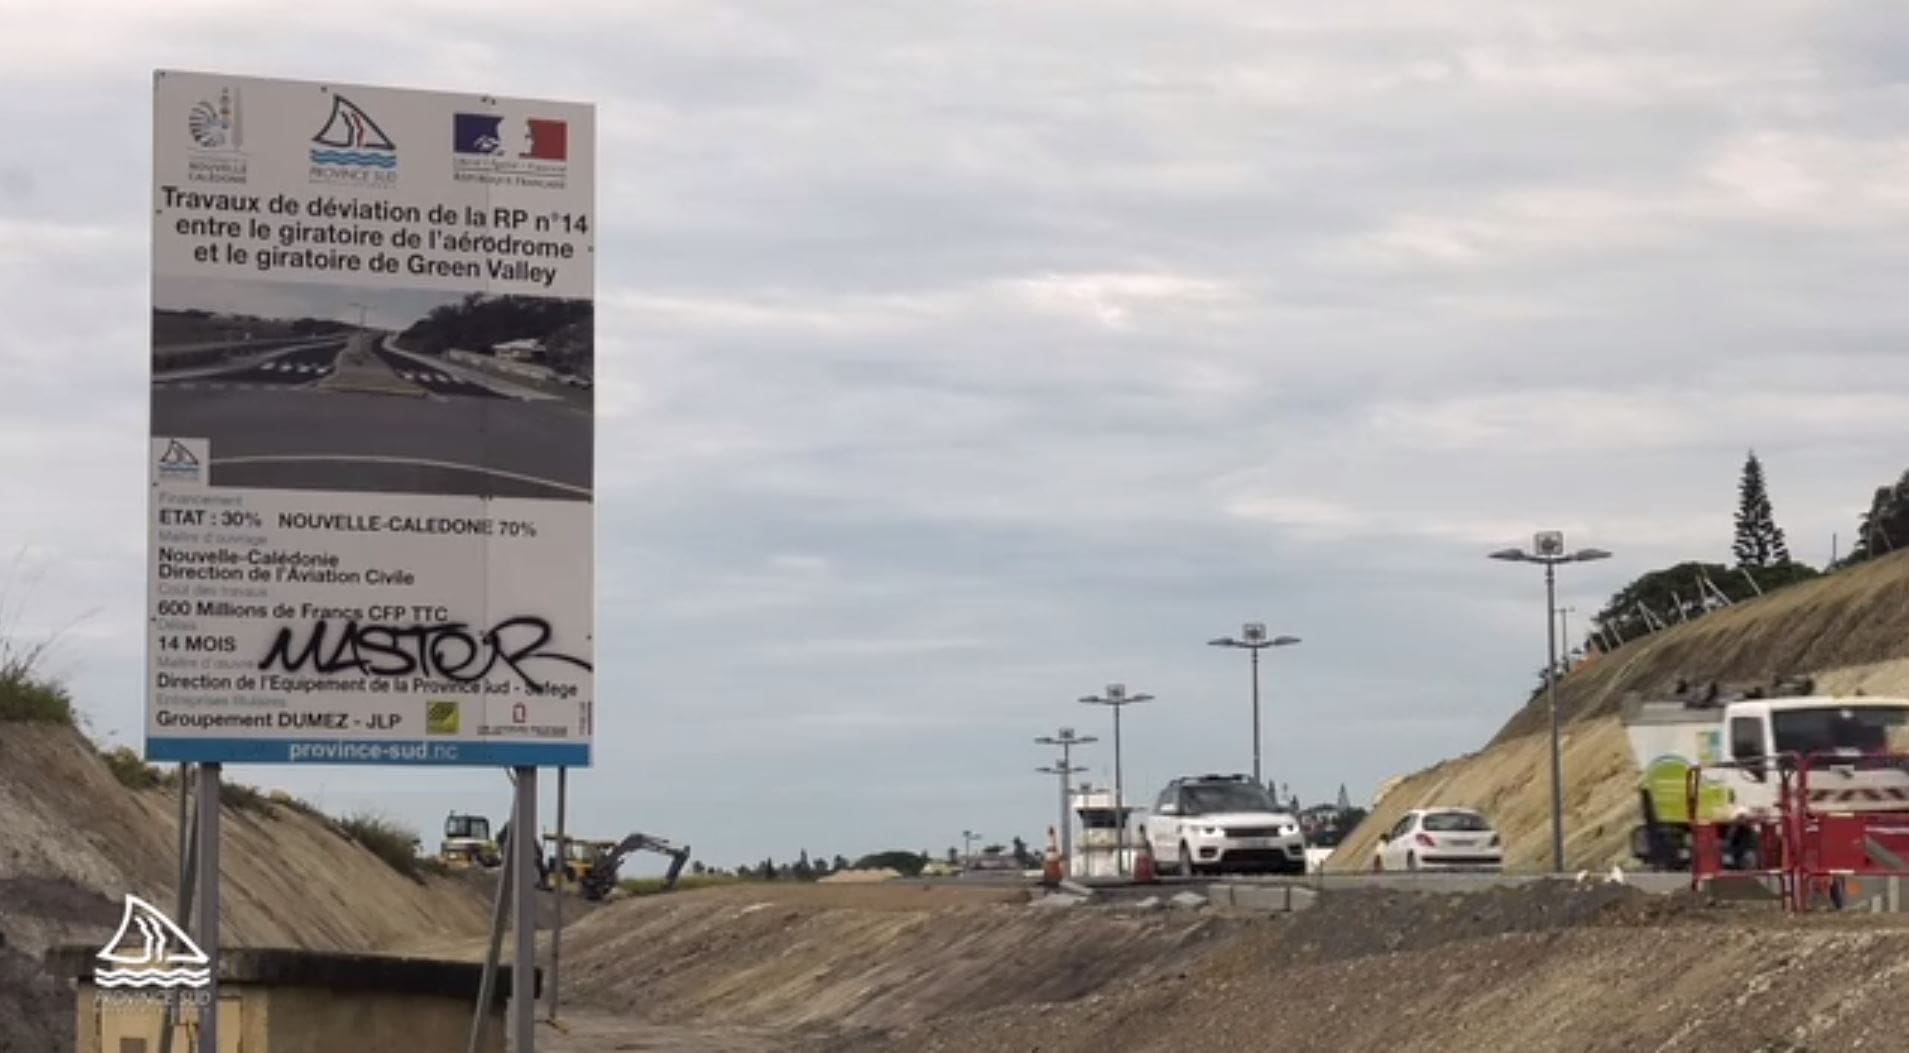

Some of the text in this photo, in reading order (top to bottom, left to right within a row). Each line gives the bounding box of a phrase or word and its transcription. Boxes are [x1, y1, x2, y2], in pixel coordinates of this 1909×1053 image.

[161, 185, 588, 235] Travaux de déviation de la RP n°14
[176, 217, 574, 259] entre le giratoire de l'aérodrome
[194, 243, 556, 287] et le giratoire de Green Valley
[159, 510, 205, 526] ETAT
[222, 511, 262, 528] 30%
[499, 519, 537, 538] 70%
[158, 547, 339, 568] Nouvelle-Calédonie
[158, 564, 414, 585] Direction de l'Aviation Civile
[158, 601, 448, 622] 600 Millions de Francs CFP TTC
[158, 635, 236, 652] 14 MOIS
[157, 672, 232, 689] Direction
[236, 675, 256, 690] de
[369, 677, 389, 692] de
[393, 677, 408, 692] la
[414, 677, 480, 695] Province
[157, 710, 272, 730] Groupement
[278, 713, 349, 730] DUMEZ
[366, 714, 402, 731] JLP
[289, 740, 459, 764] province-sud.nc
